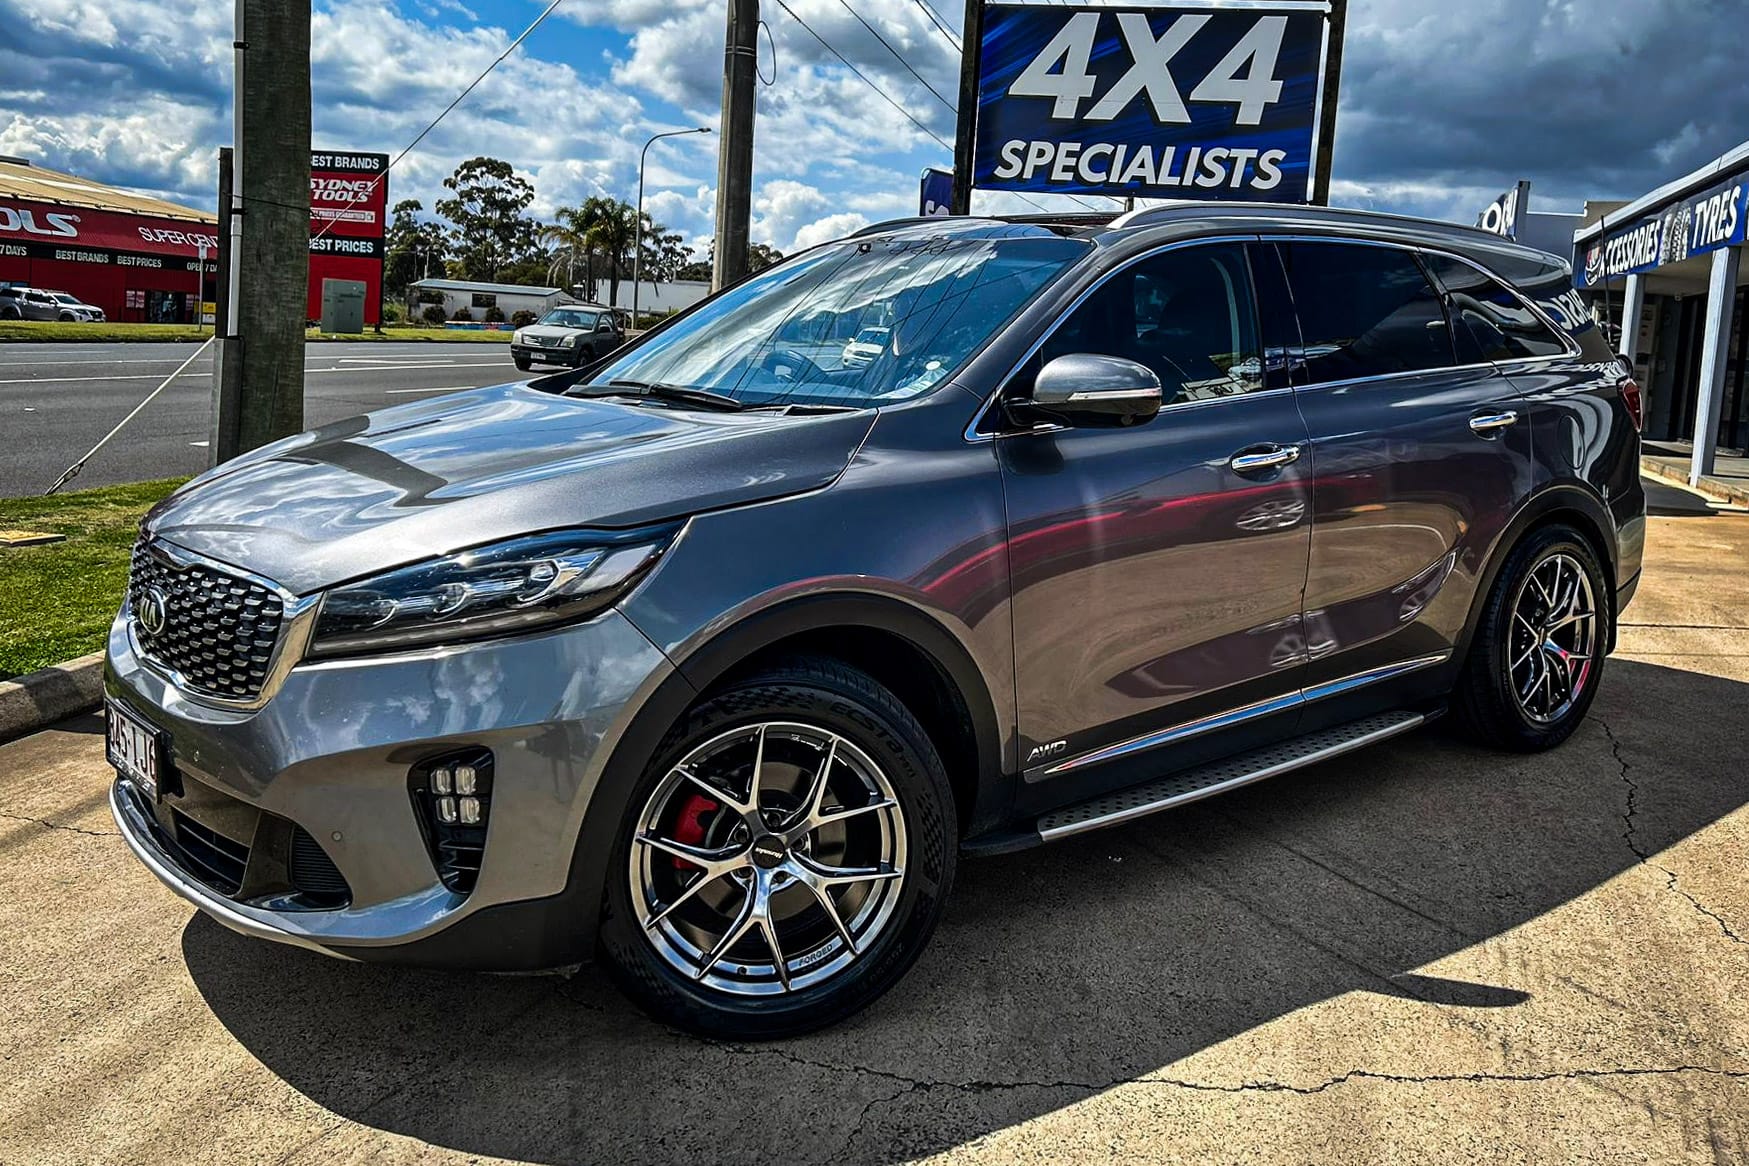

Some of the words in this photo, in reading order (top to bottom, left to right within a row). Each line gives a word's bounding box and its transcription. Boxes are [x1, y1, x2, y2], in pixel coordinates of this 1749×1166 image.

[1008, 12, 1288, 126] 4X4
[310, 155, 333, 168] EST
[335, 156, 380, 170] BRANDS
[993, 138, 1287, 191] SPECIALISTS
[310, 178, 379, 193] SYDNEY
[313, 189, 369, 203] TOOLS
[1692, 186, 1742, 249] TYRES
[138, 226, 190, 245] SUPER
[5, 245, 28, 257] DAYS
[335, 239, 374, 253] PRICES
[56, 250, 76, 260] BEST
[76, 251, 109, 264] BRANDS
[117, 255, 136, 267] BEST
[136, 256, 162, 268] PRICES
[1027, 740, 1067, 762] AWD
